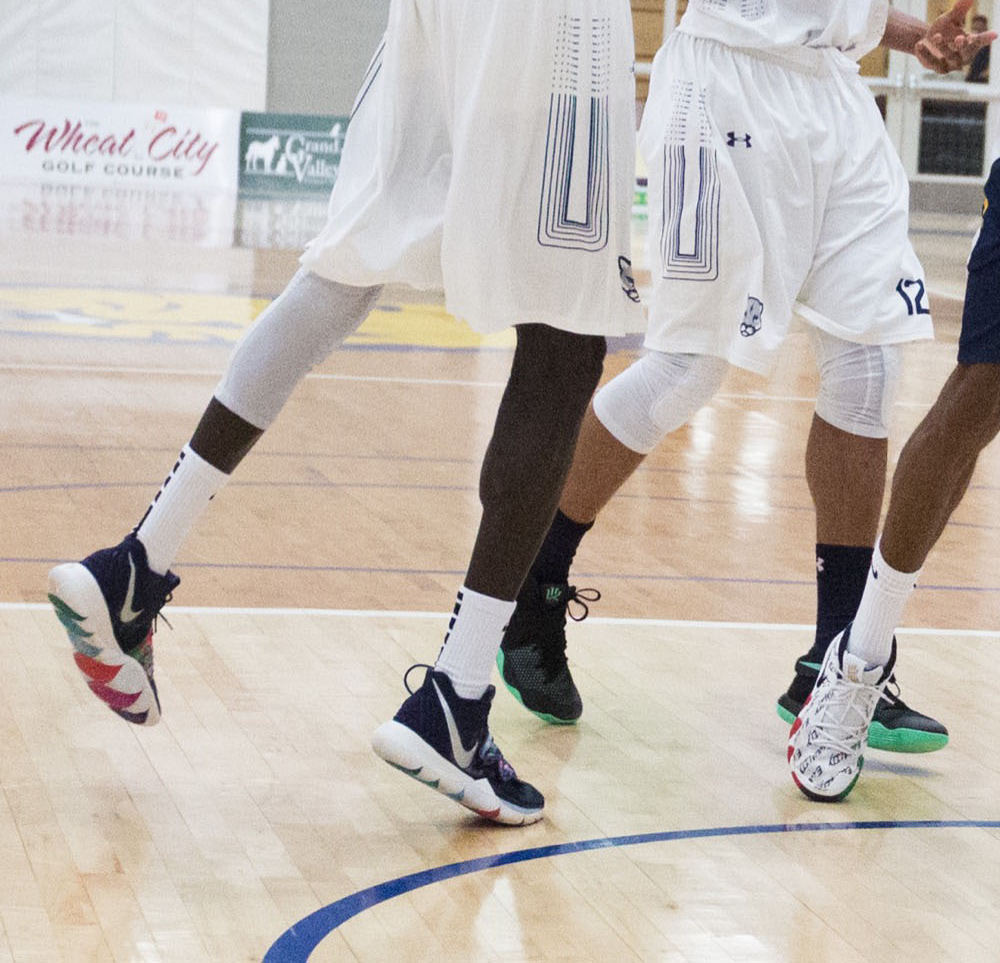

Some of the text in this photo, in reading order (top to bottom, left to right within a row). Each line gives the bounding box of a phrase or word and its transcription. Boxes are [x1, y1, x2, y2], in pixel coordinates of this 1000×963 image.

[14, 119, 218, 176] Wheat City
[41, 160, 185, 178] GOLF COURSE
[896, 278, 930, 316] 12
